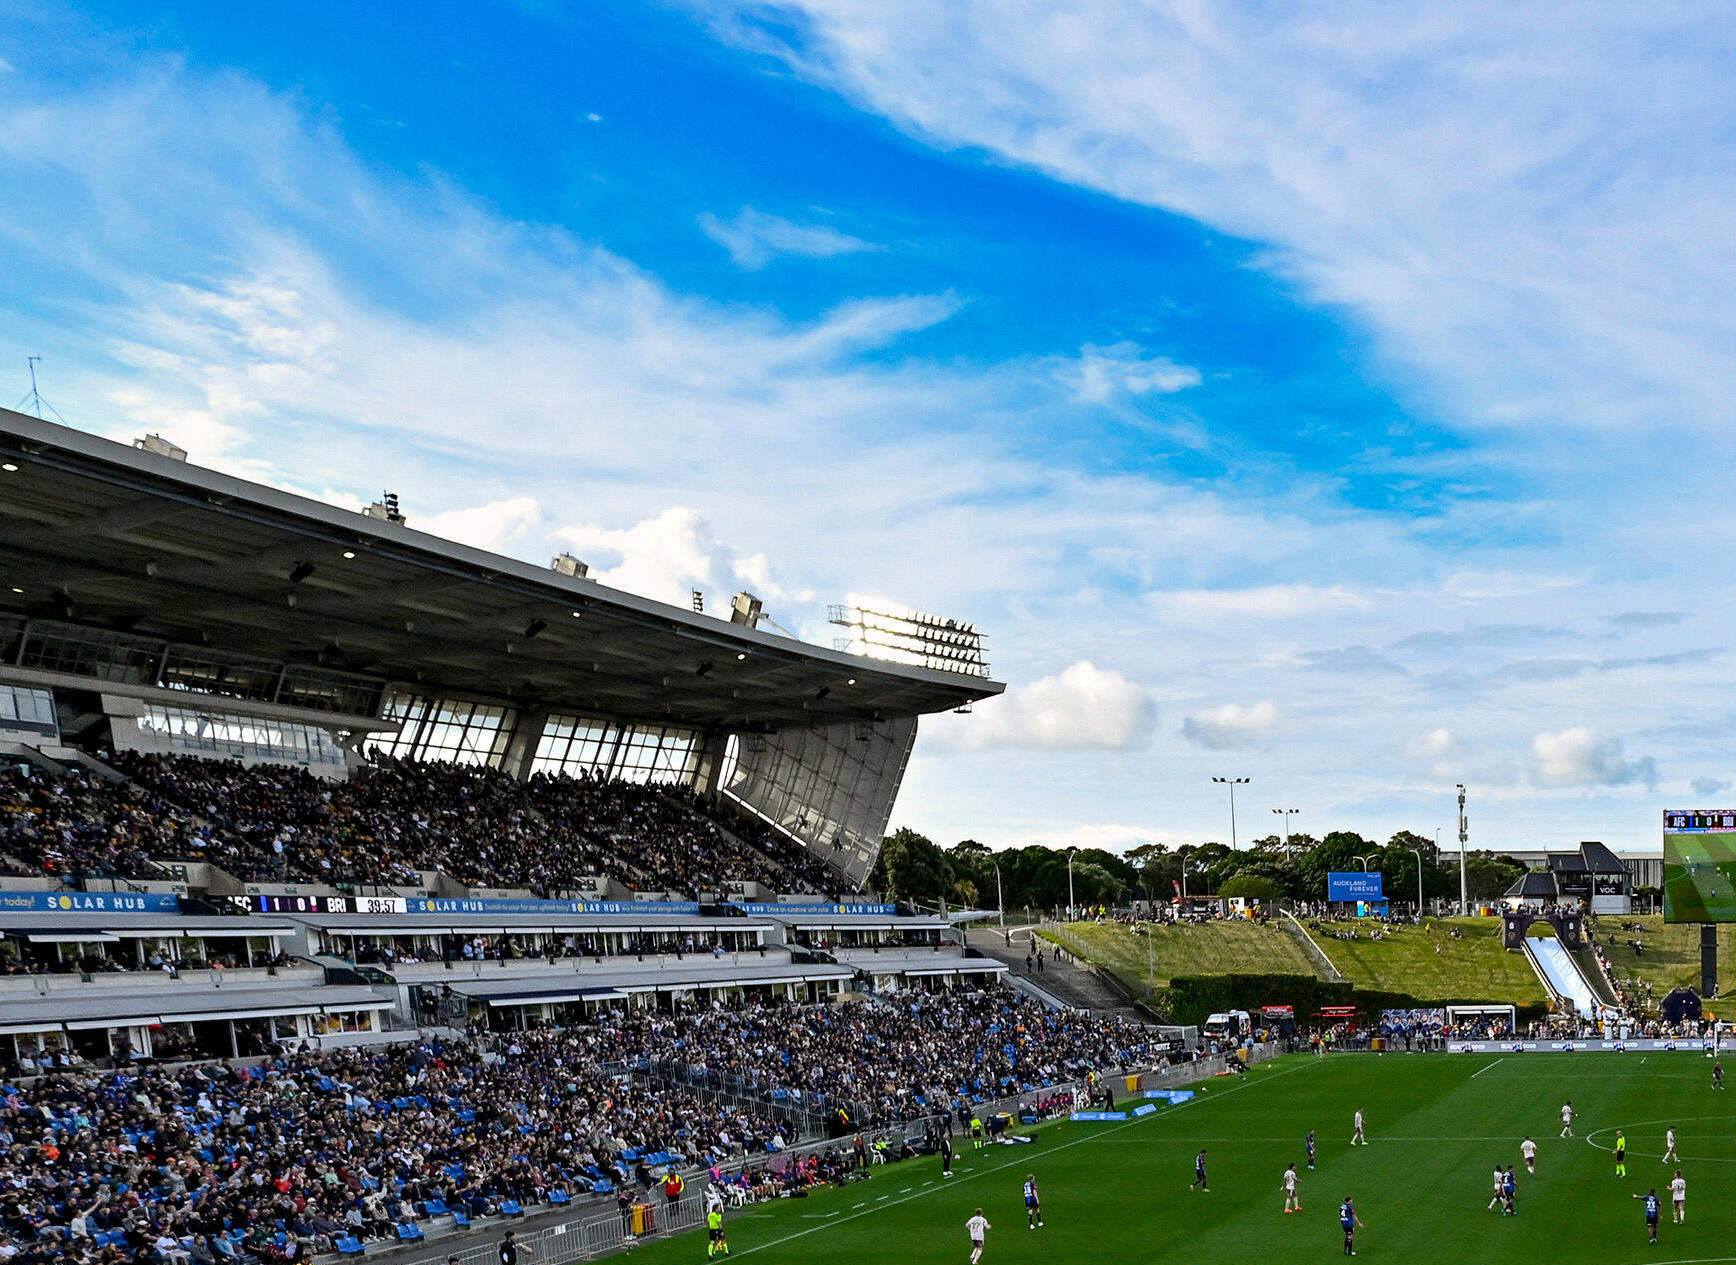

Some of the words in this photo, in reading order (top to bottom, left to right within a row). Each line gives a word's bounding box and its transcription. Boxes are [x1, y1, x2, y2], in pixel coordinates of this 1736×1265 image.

[1673, 816, 1686, 827] AFC
[47, 896, 105, 910] SOLAR
[114, 897, 146, 910] HUB
[326, 898, 347, 913] BRI
[367, 899, 395, 913] 39:57
[419, 900, 457, 912] SOLAR
[463, 901, 484, 911] HUB
[571, 903, 600, 913] SOLAR
[604, 904, 621, 912] HUB
[833, 905, 863, 914] SOLAR
[867, 905, 884, 913] HUB
[1646, 1201, 1655, 1209] 23
